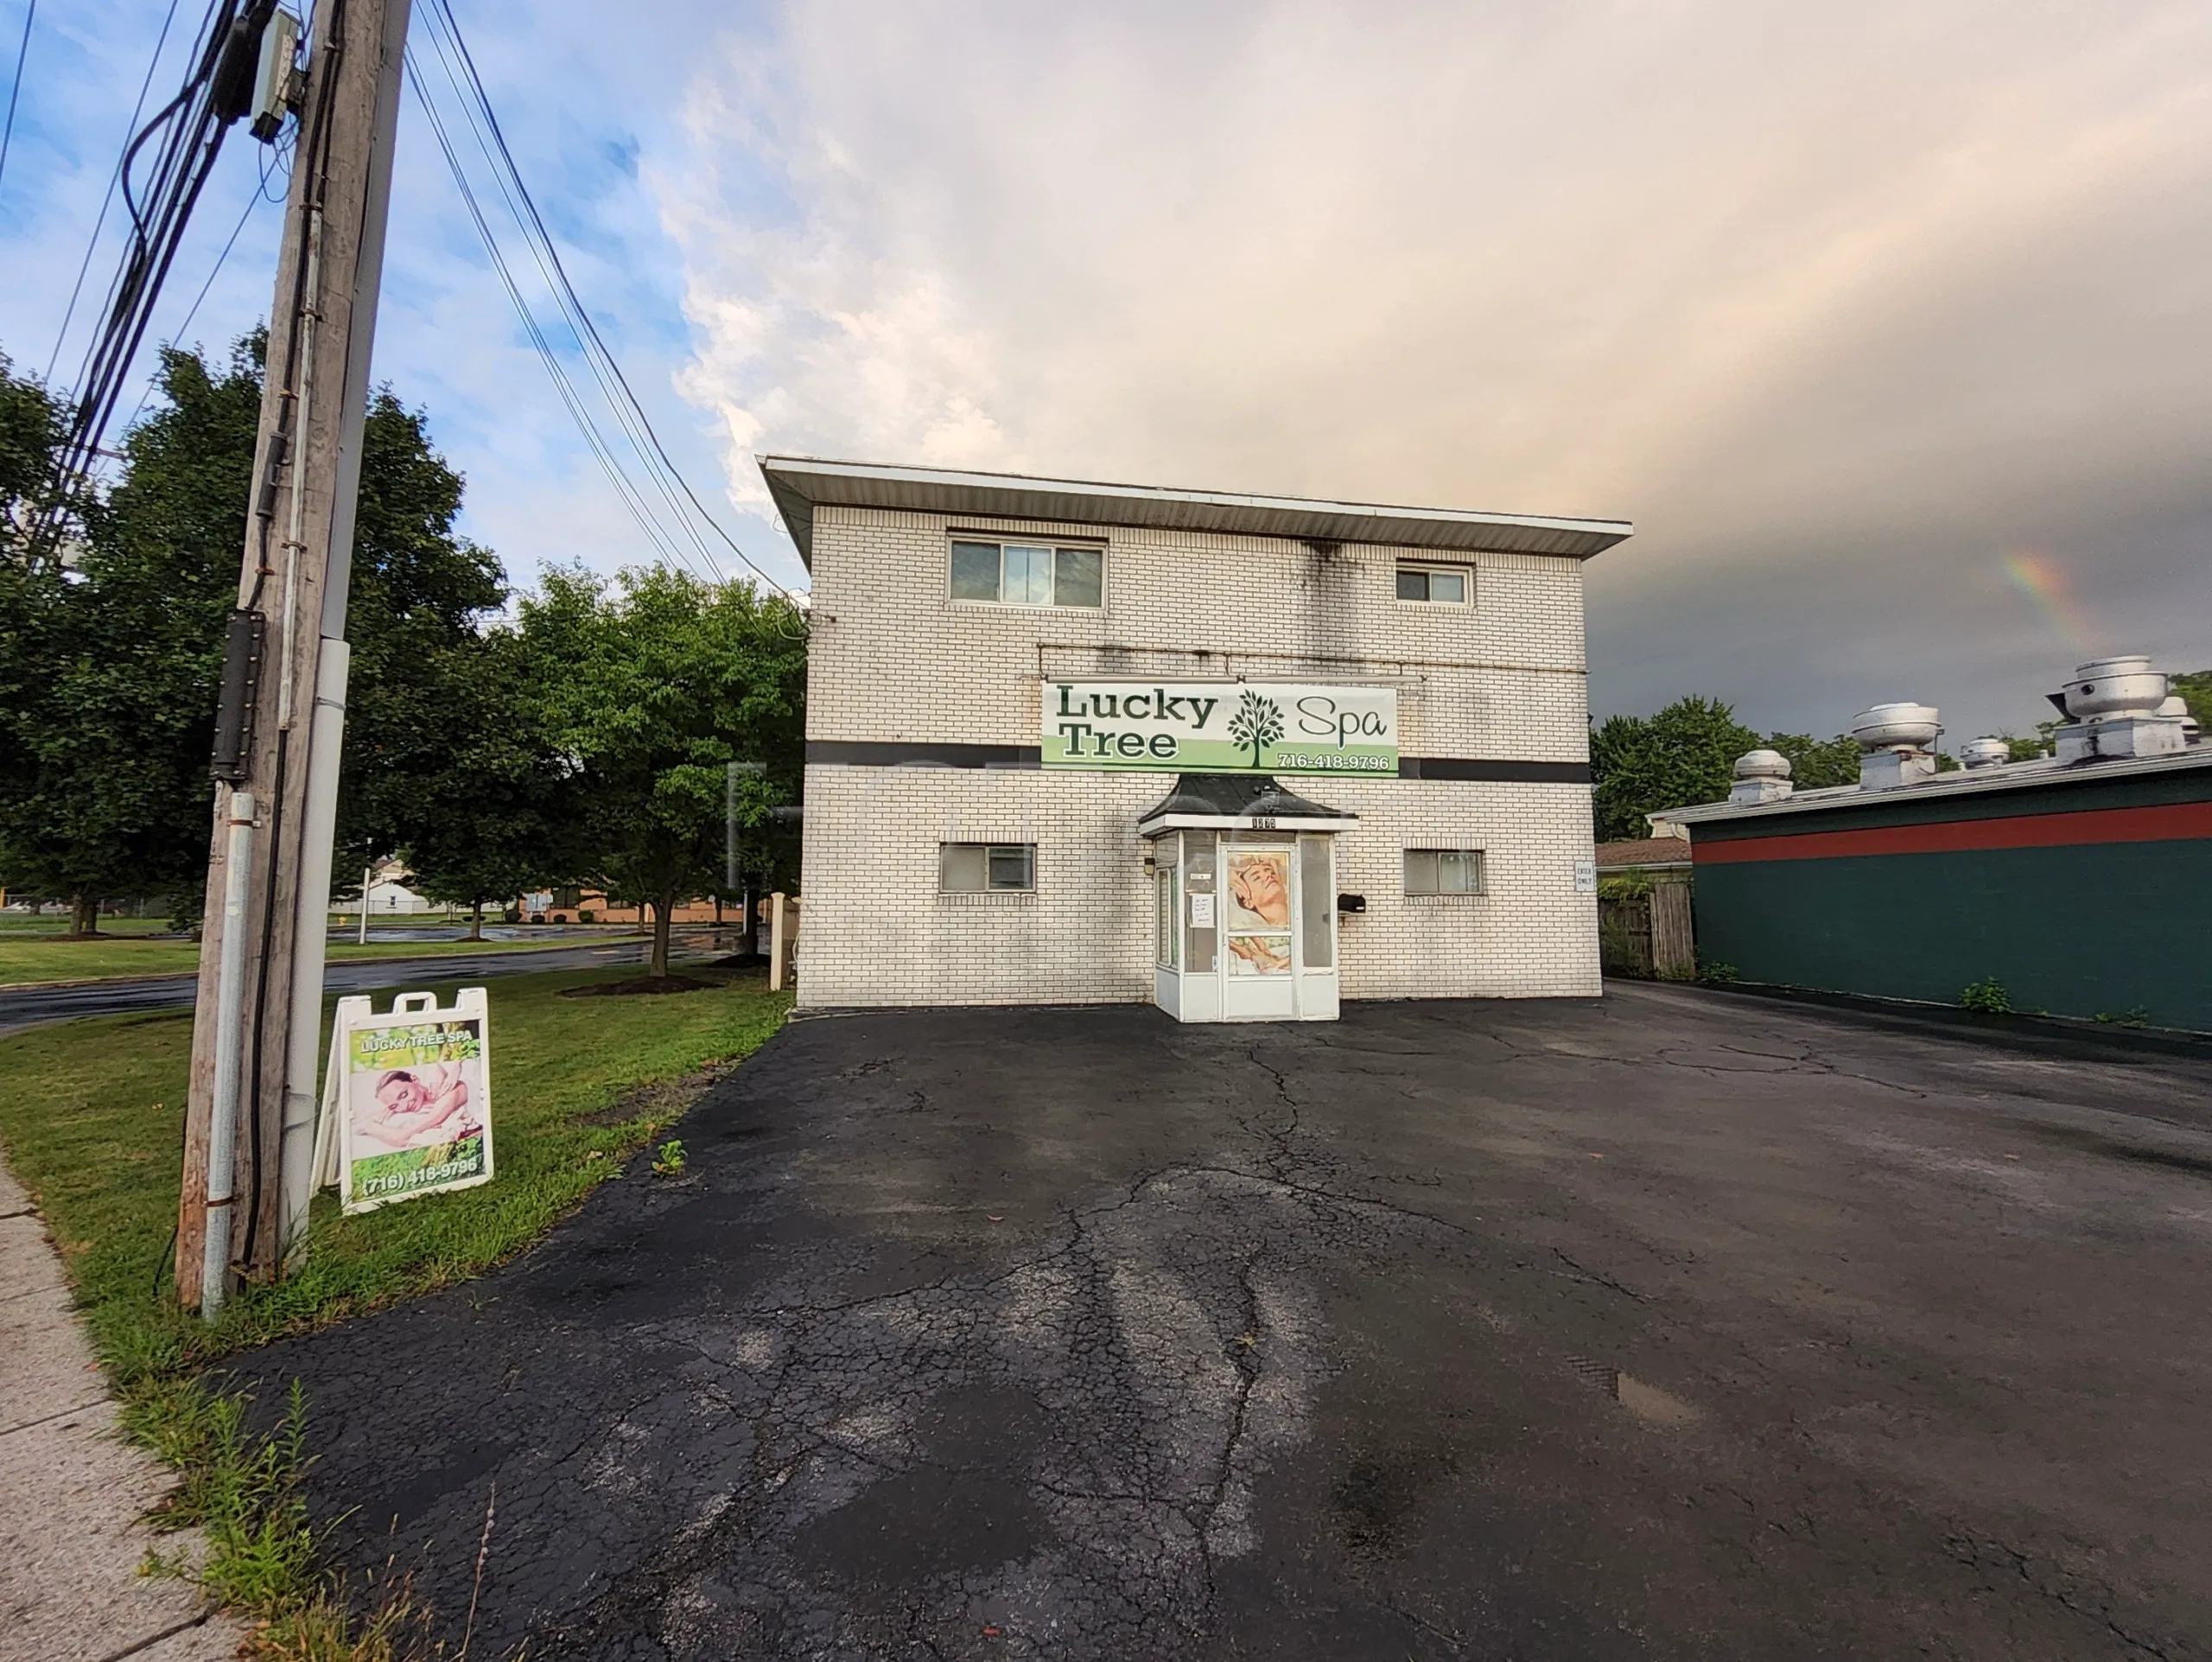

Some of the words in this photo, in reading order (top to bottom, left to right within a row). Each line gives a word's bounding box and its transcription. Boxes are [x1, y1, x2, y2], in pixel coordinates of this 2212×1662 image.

[1056, 685, 1219, 729] Lucky
[1296, 696, 1388, 749] Spa
[1058, 723, 1179, 759] Tree
[1277, 753, 1389, 770] 716-418-9796
[360, 1037, 410, 1054] LUCKY
[410, 1032, 445, 1048] TREE
[447, 1029, 474, 1043] SPA
[363, 1172, 405, 1197] (716)
[407, 1158, 478, 1185] 418-9796
